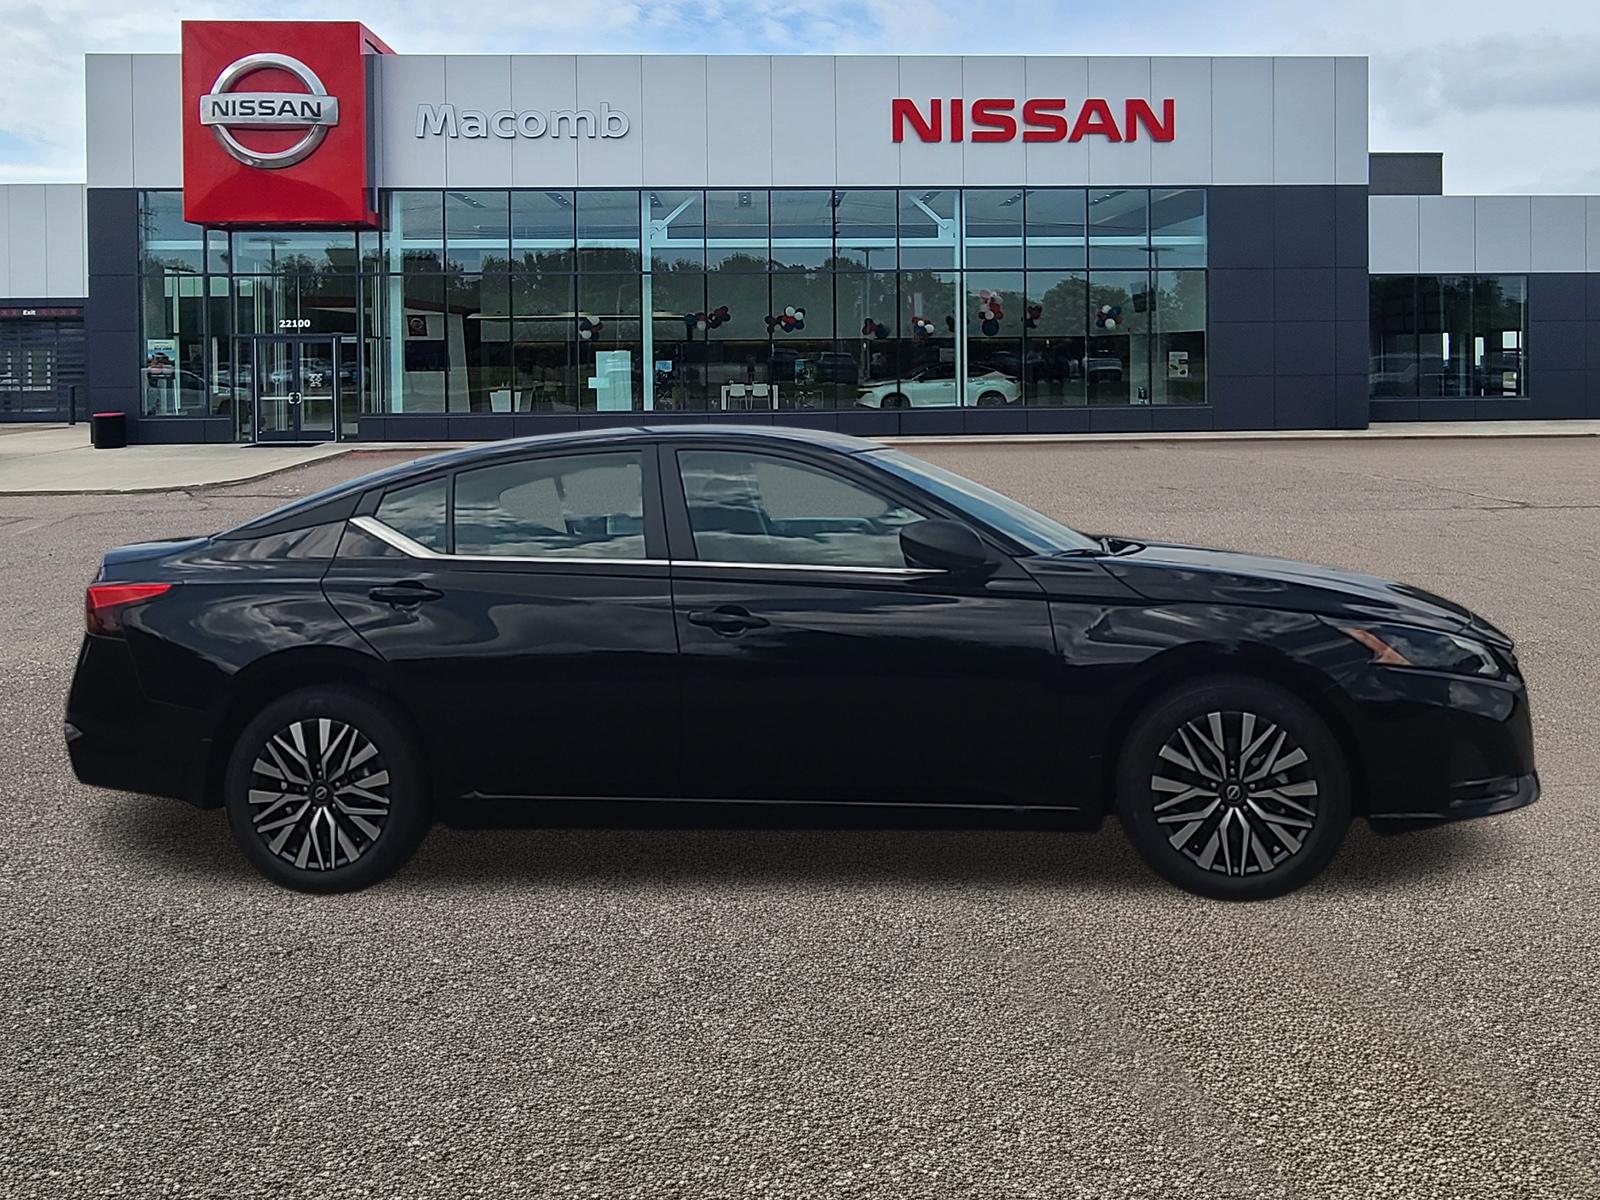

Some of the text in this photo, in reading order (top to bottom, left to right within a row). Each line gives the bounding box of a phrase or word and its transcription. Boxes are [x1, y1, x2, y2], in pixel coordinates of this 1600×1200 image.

[211, 100, 322, 118] NISSAN
[415, 102, 630, 138] Macomb
[892, 99, 1175, 143] NISSAN
[279, 319, 311, 328] 22100
